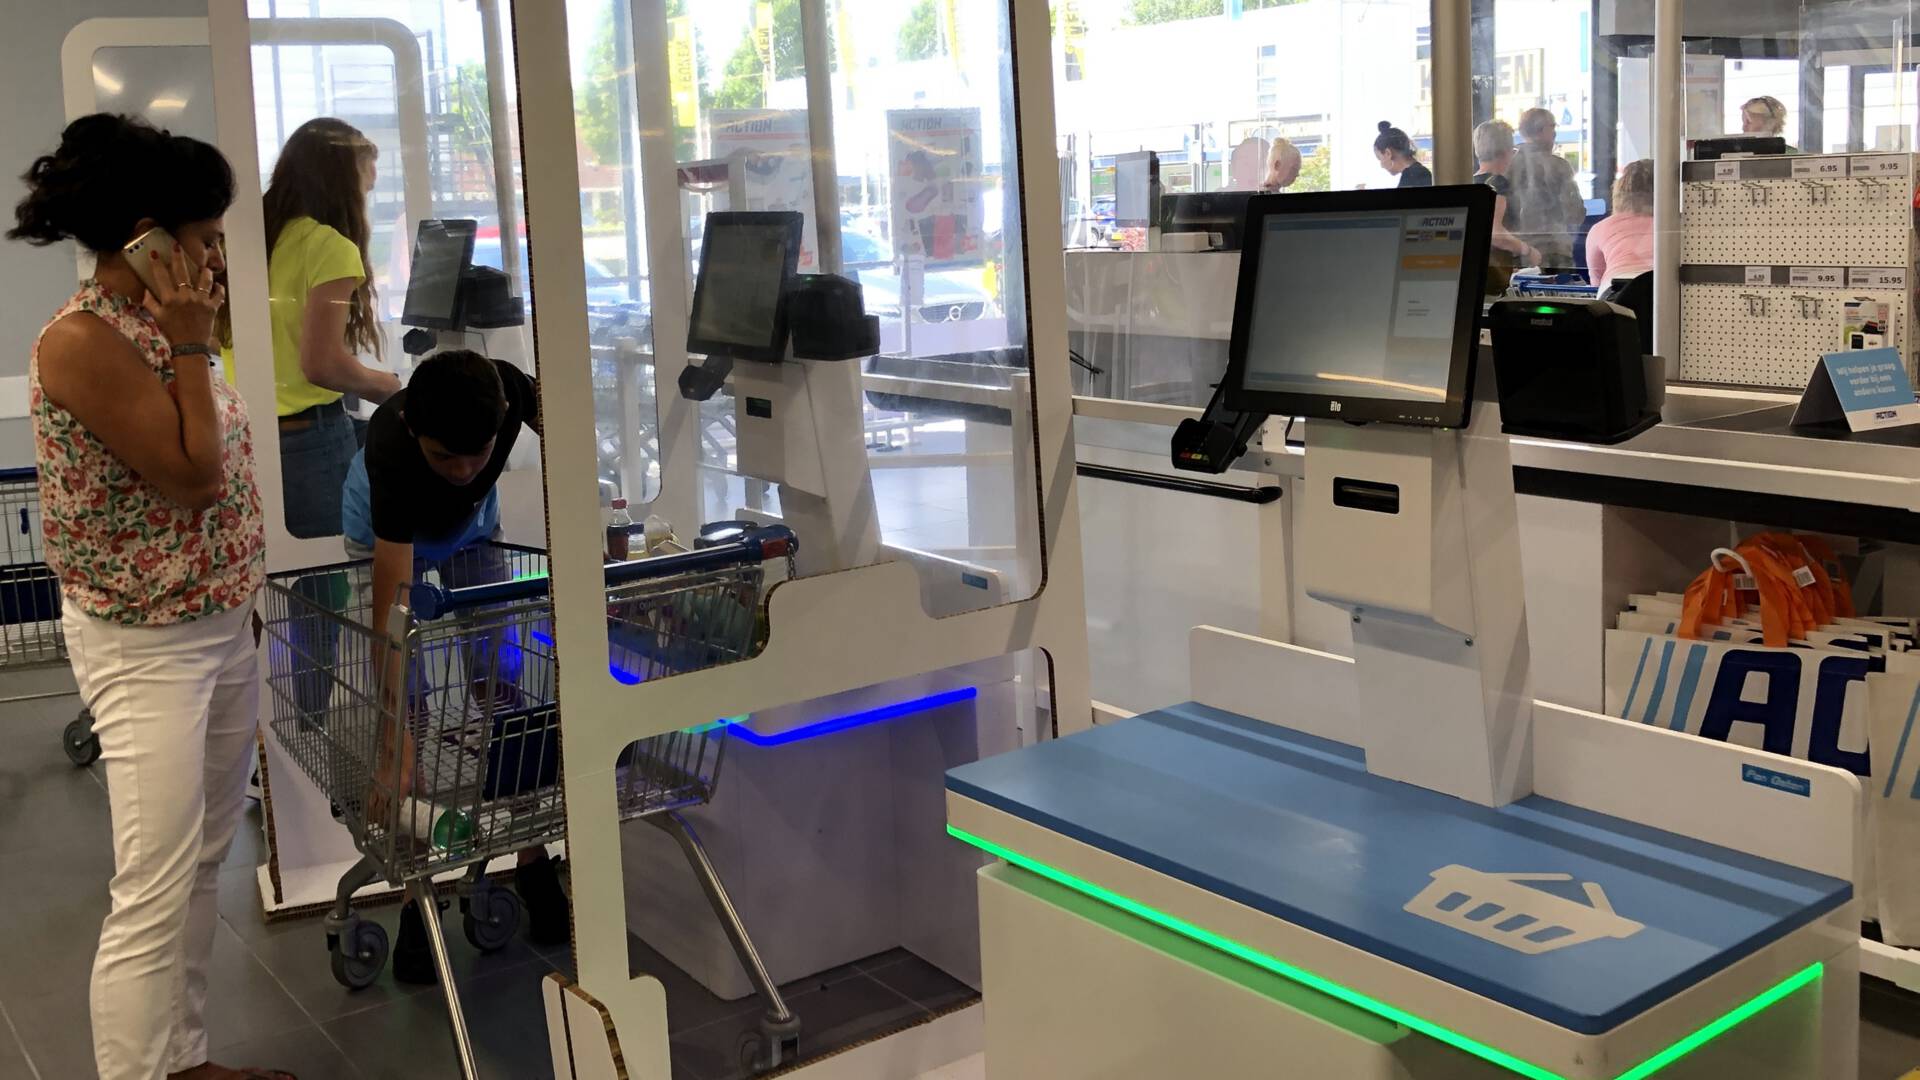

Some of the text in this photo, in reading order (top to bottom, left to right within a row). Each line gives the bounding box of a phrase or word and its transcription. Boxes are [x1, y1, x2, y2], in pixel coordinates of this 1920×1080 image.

[1879, 162, 1898, 170] 9.95
[1422, 216, 1455, 227] ACTION
[1879, 276, 1902, 284] 15.95
